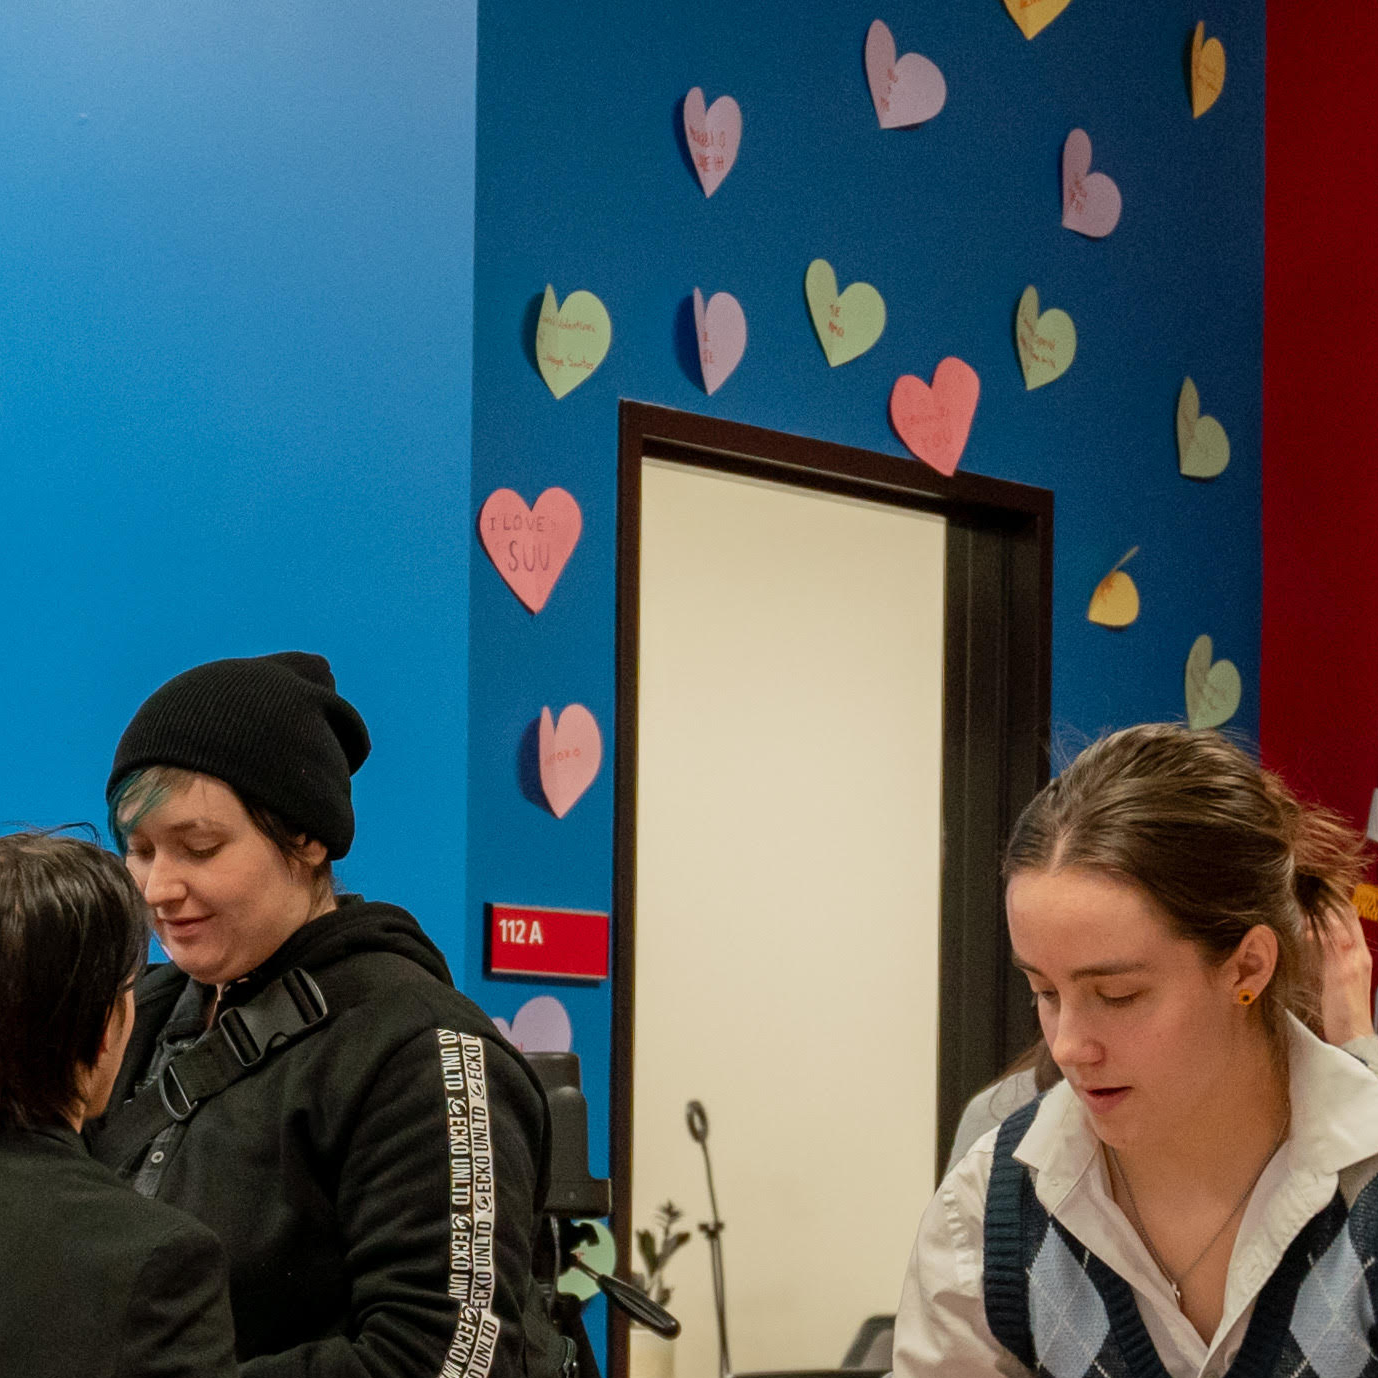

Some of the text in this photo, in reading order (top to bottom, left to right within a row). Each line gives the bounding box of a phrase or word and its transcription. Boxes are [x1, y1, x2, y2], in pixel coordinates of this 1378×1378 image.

[503, 514, 546, 532] LOVE
[508, 540, 550, 573] SUU
[499, 918, 543, 945] 112 A
[440, 1047, 465, 1091] UNLTD
[471, 1105, 490, 1152] UNLTD
[451, 1158, 473, 1206] UNLTD
[474, 1220, 492, 1267] UNLTD
[476, 1319, 498, 1369] UNLTD
